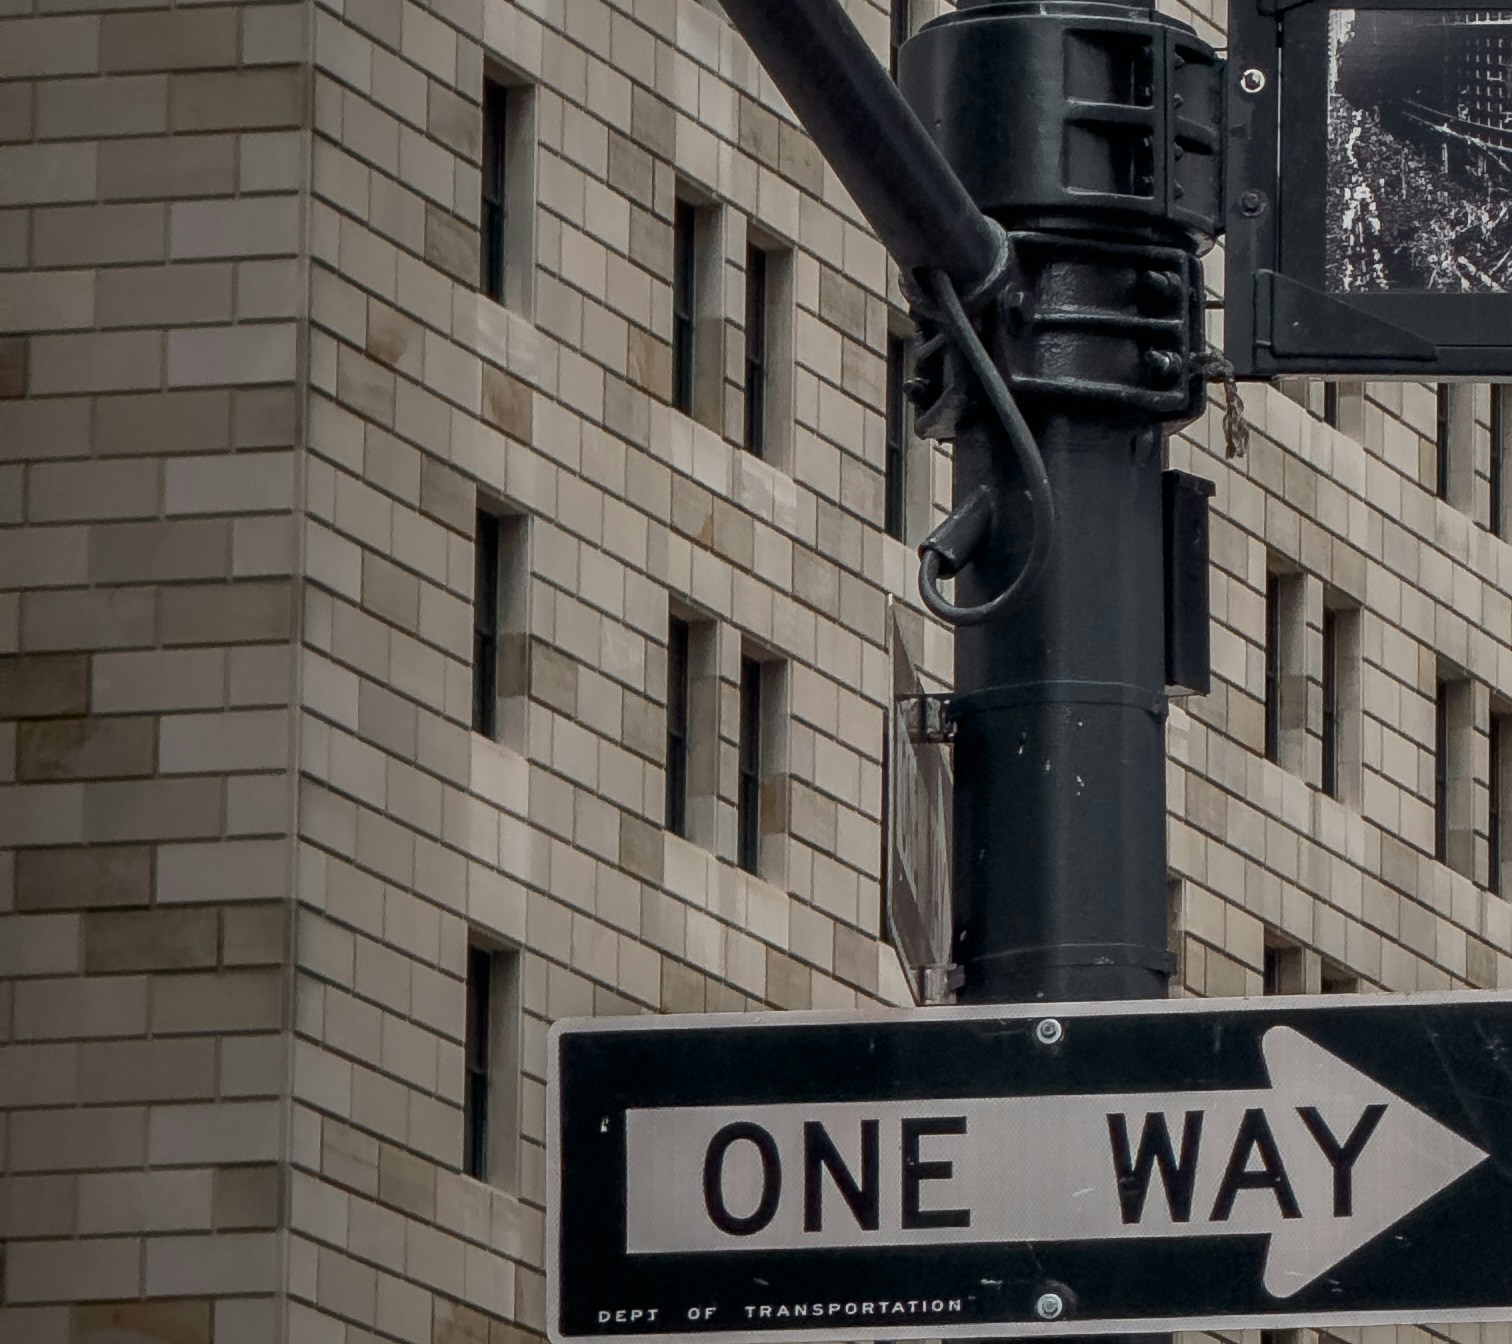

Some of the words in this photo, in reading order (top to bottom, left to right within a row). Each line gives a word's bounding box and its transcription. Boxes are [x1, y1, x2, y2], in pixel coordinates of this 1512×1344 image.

[702, 1116, 971, 1237] ONE
[1106, 1102, 1389, 1225] WAY
[598, 1308, 659, 1323] DEPT
[687, 1306, 717, 1321] OF
[744, 1297, 962, 1319] TRANSPORTATION
